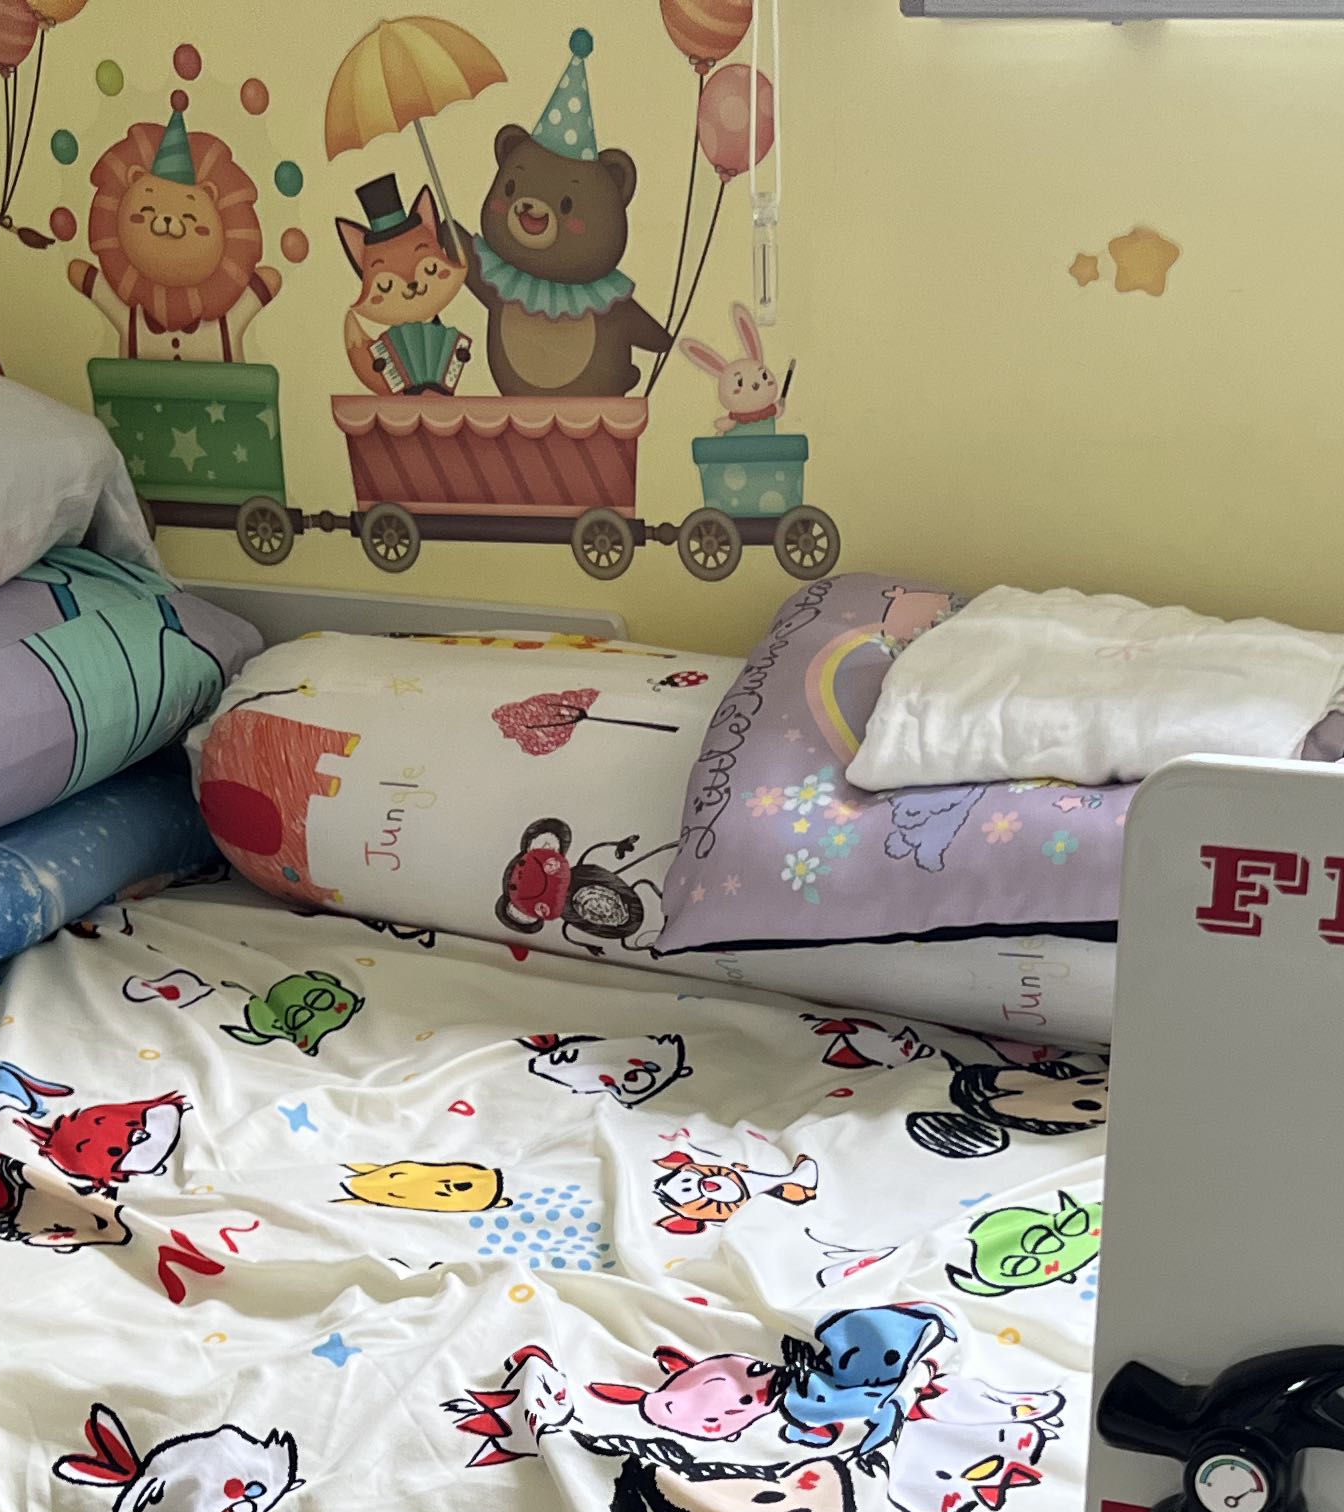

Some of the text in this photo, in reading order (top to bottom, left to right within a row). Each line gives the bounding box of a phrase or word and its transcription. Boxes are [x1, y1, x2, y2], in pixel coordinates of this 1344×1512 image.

[770, 575, 840, 641] Sta
[364, 764, 438, 872] Jungle
[996, 937, 1071, 1026] Jungle
